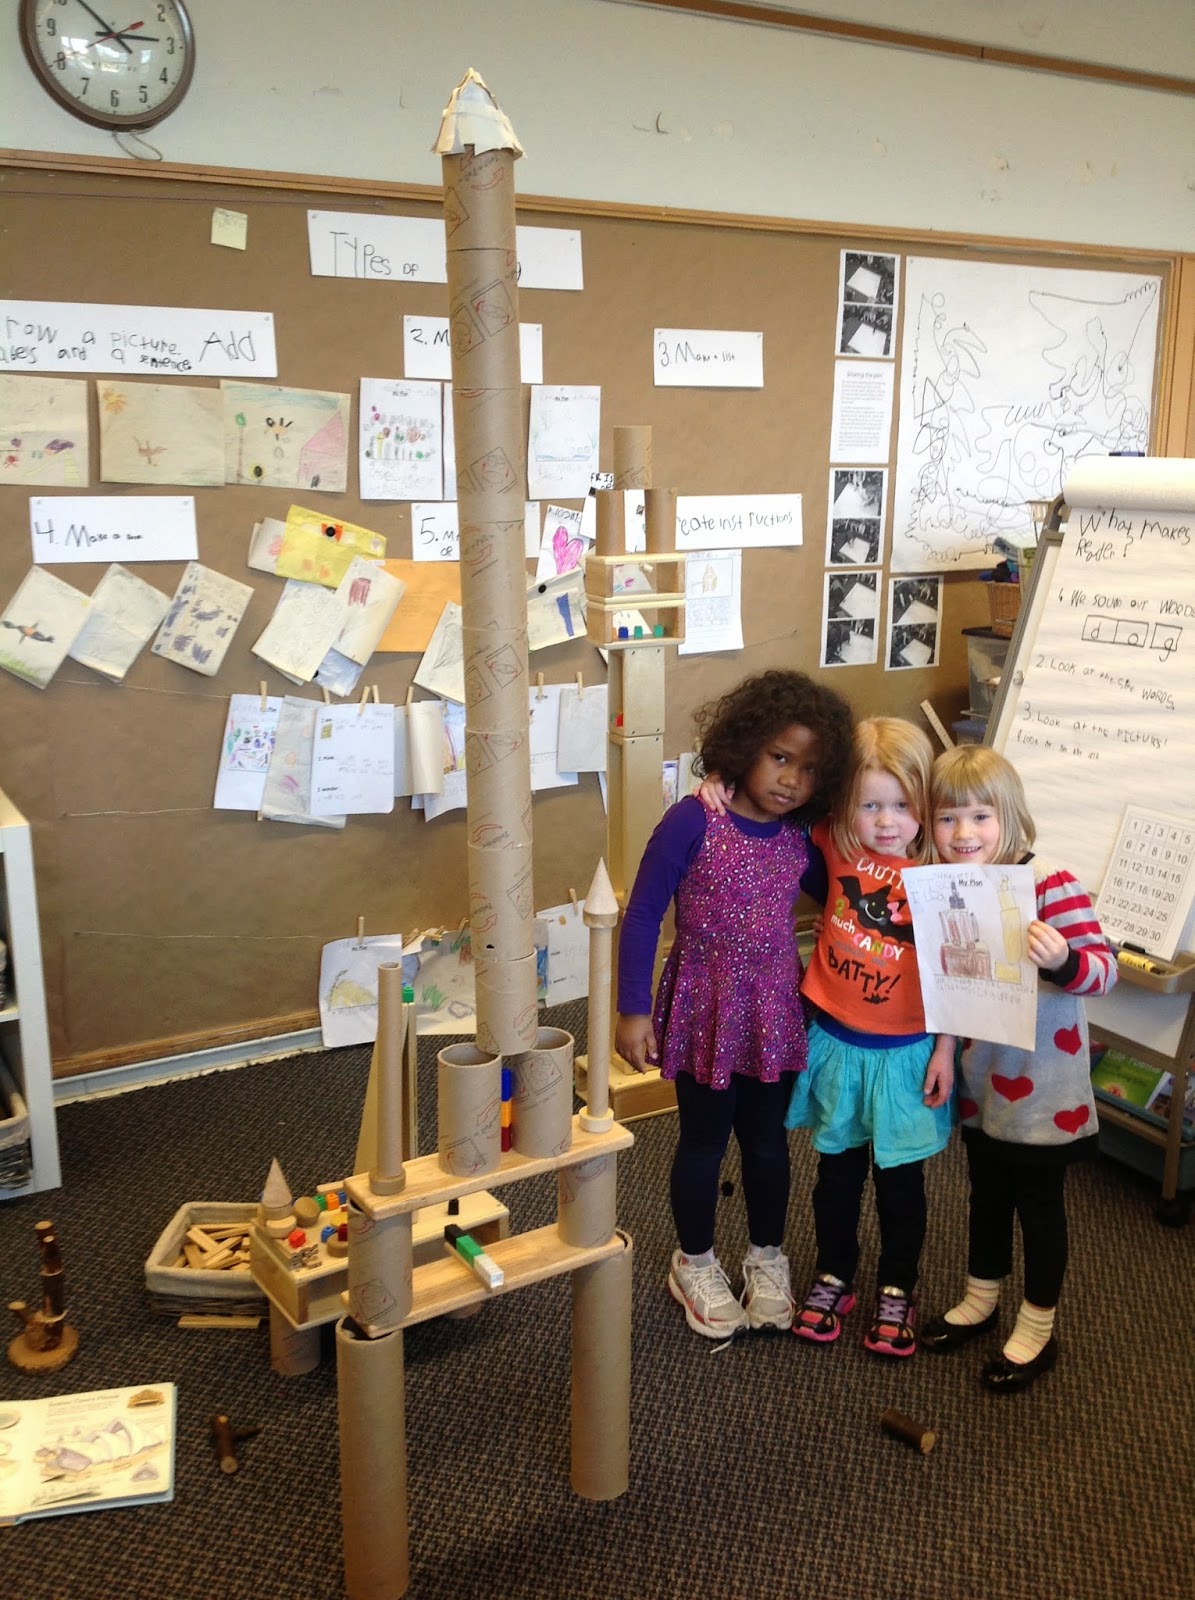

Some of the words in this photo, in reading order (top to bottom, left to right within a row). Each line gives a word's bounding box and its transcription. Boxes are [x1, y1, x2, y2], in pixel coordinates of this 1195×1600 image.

[158, 5, 165, 21] 2
[47, 18, 56, 36] 9
[167, 37, 174, 54] 3
[57, 52, 65, 69] 8
[159, 68, 167, 84] 4
[81, 77, 89, 95] 7
[139, 86, 147, 103] 5
[110, 90, 119, 106] 6
[57, 346, 87, 361] and
[82, 331, 96, 345] a
[199, 331, 257, 362] Add
[1073, 721, 1087, 731] at
[1134, 822, 1137, 830] 1
[1145, 825, 1151, 834] 2
[1158, 829, 1163, 837] 3
[1171, 832, 1177, 840] 4
[1185, 835, 1190, 844] 5
[1126, 840, 1131, 849] 6
[1140, 844, 1145, 852] 7
[1152, 847, 1157, 856] 8
[1165, 851, 1171, 859] 9
[1177, 854, 1187, 864] 10
[1120, 859, 1127, 868] 11
[1132, 862, 1141, 871] 12
[1145, 866, 1154, 875] 13
[1158, 870, 1167, 879] 14
[1172, 873, 1181, 883] 15
[1114, 877, 1122, 886] 16
[1126, 881, 1135, 890] 17
[1139, 885, 1147, 894] 18
[1152, 888, 1161, 898] 19
[1163, 892, 1174, 902] 20
[834, 898, 846, 919] 2
[1106, 895, 1115, 904] 21
[1118, 899, 1128, 909] 22
[1131, 903, 1141, 912] 23
[1143, 907, 1154, 917] 24
[1156, 911, 1167, 921] 25
[1100, 914, 1109, 923] 26
[1112, 918, 1122, 927] 27
[1124, 922, 1134, 931] 28
[1136, 926, 1147, 936] 29
[1150, 931, 1161, 941] 30
[830, 914, 856, 935] much
[853, 933, 905, 961] CANDY
